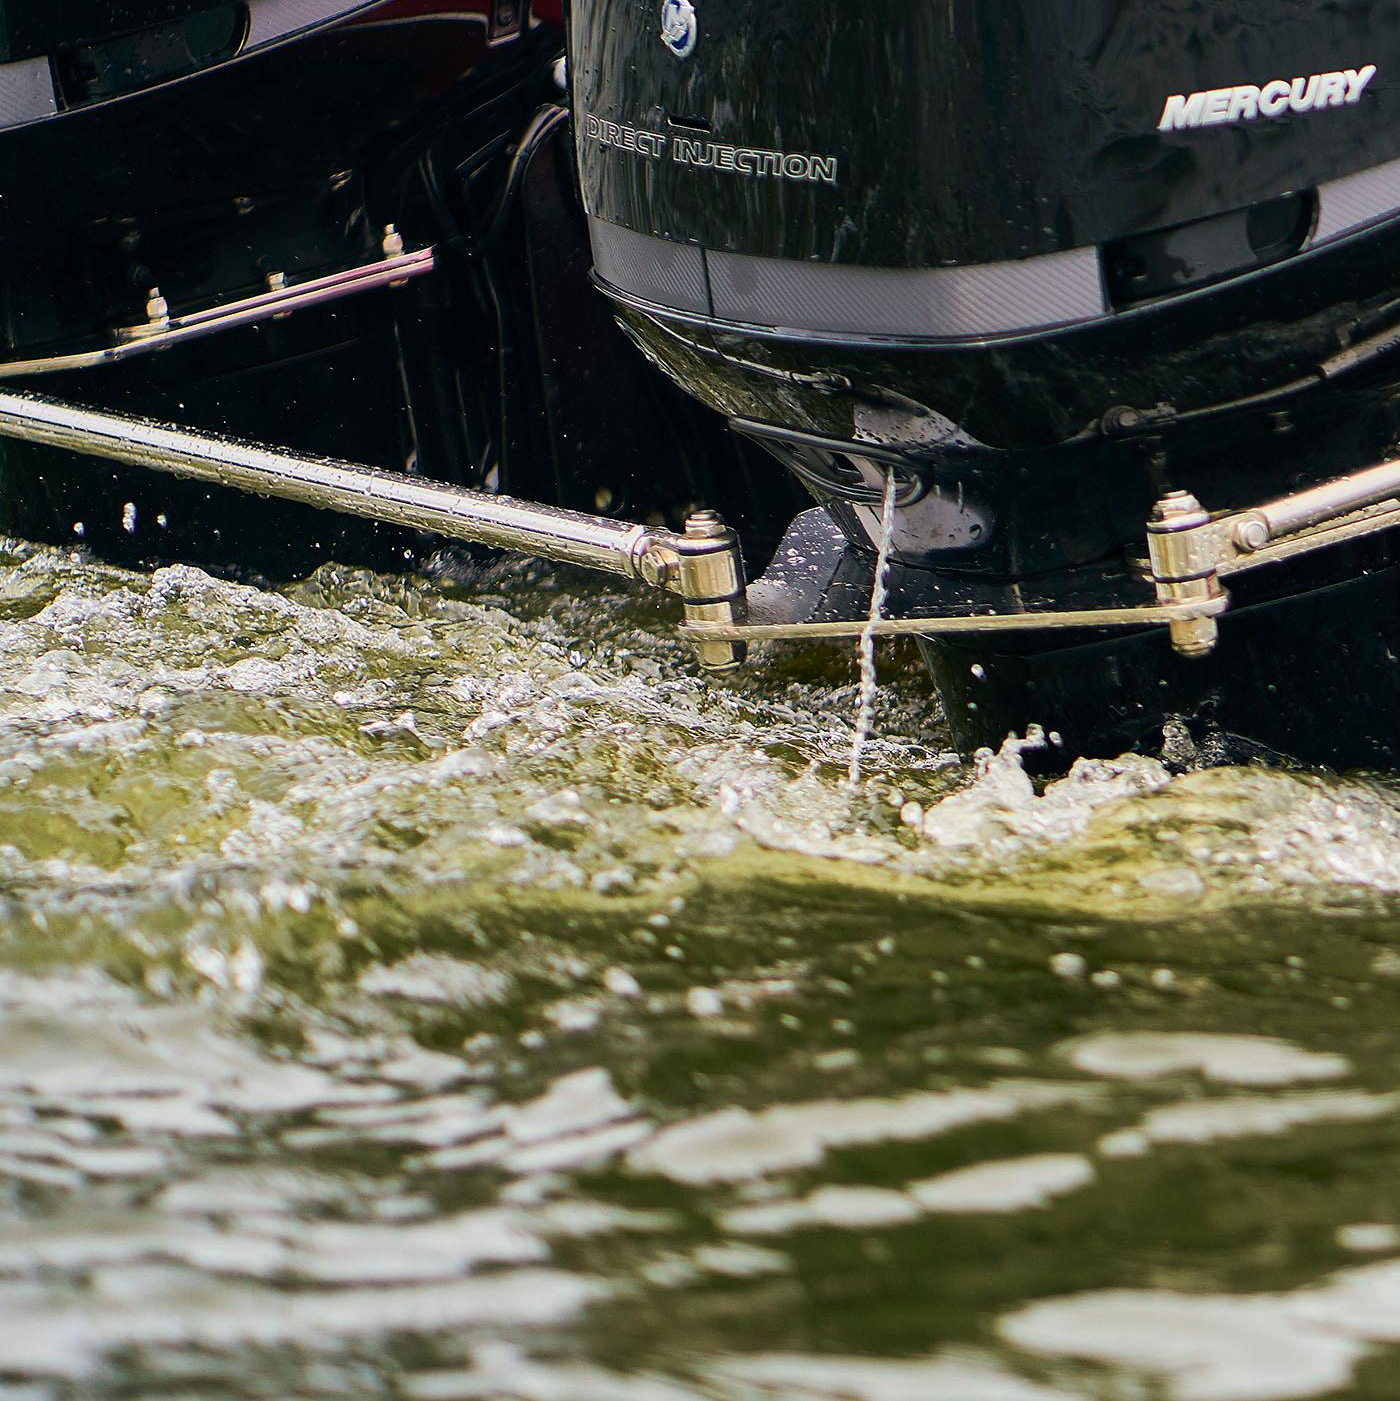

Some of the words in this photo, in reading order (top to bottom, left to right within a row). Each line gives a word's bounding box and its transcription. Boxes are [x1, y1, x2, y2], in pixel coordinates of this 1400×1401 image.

[1156, 64, 1378, 132] MERCURY
[586, 111, 665, 158] DIRECT
[672, 137, 838, 184] INJECTION
